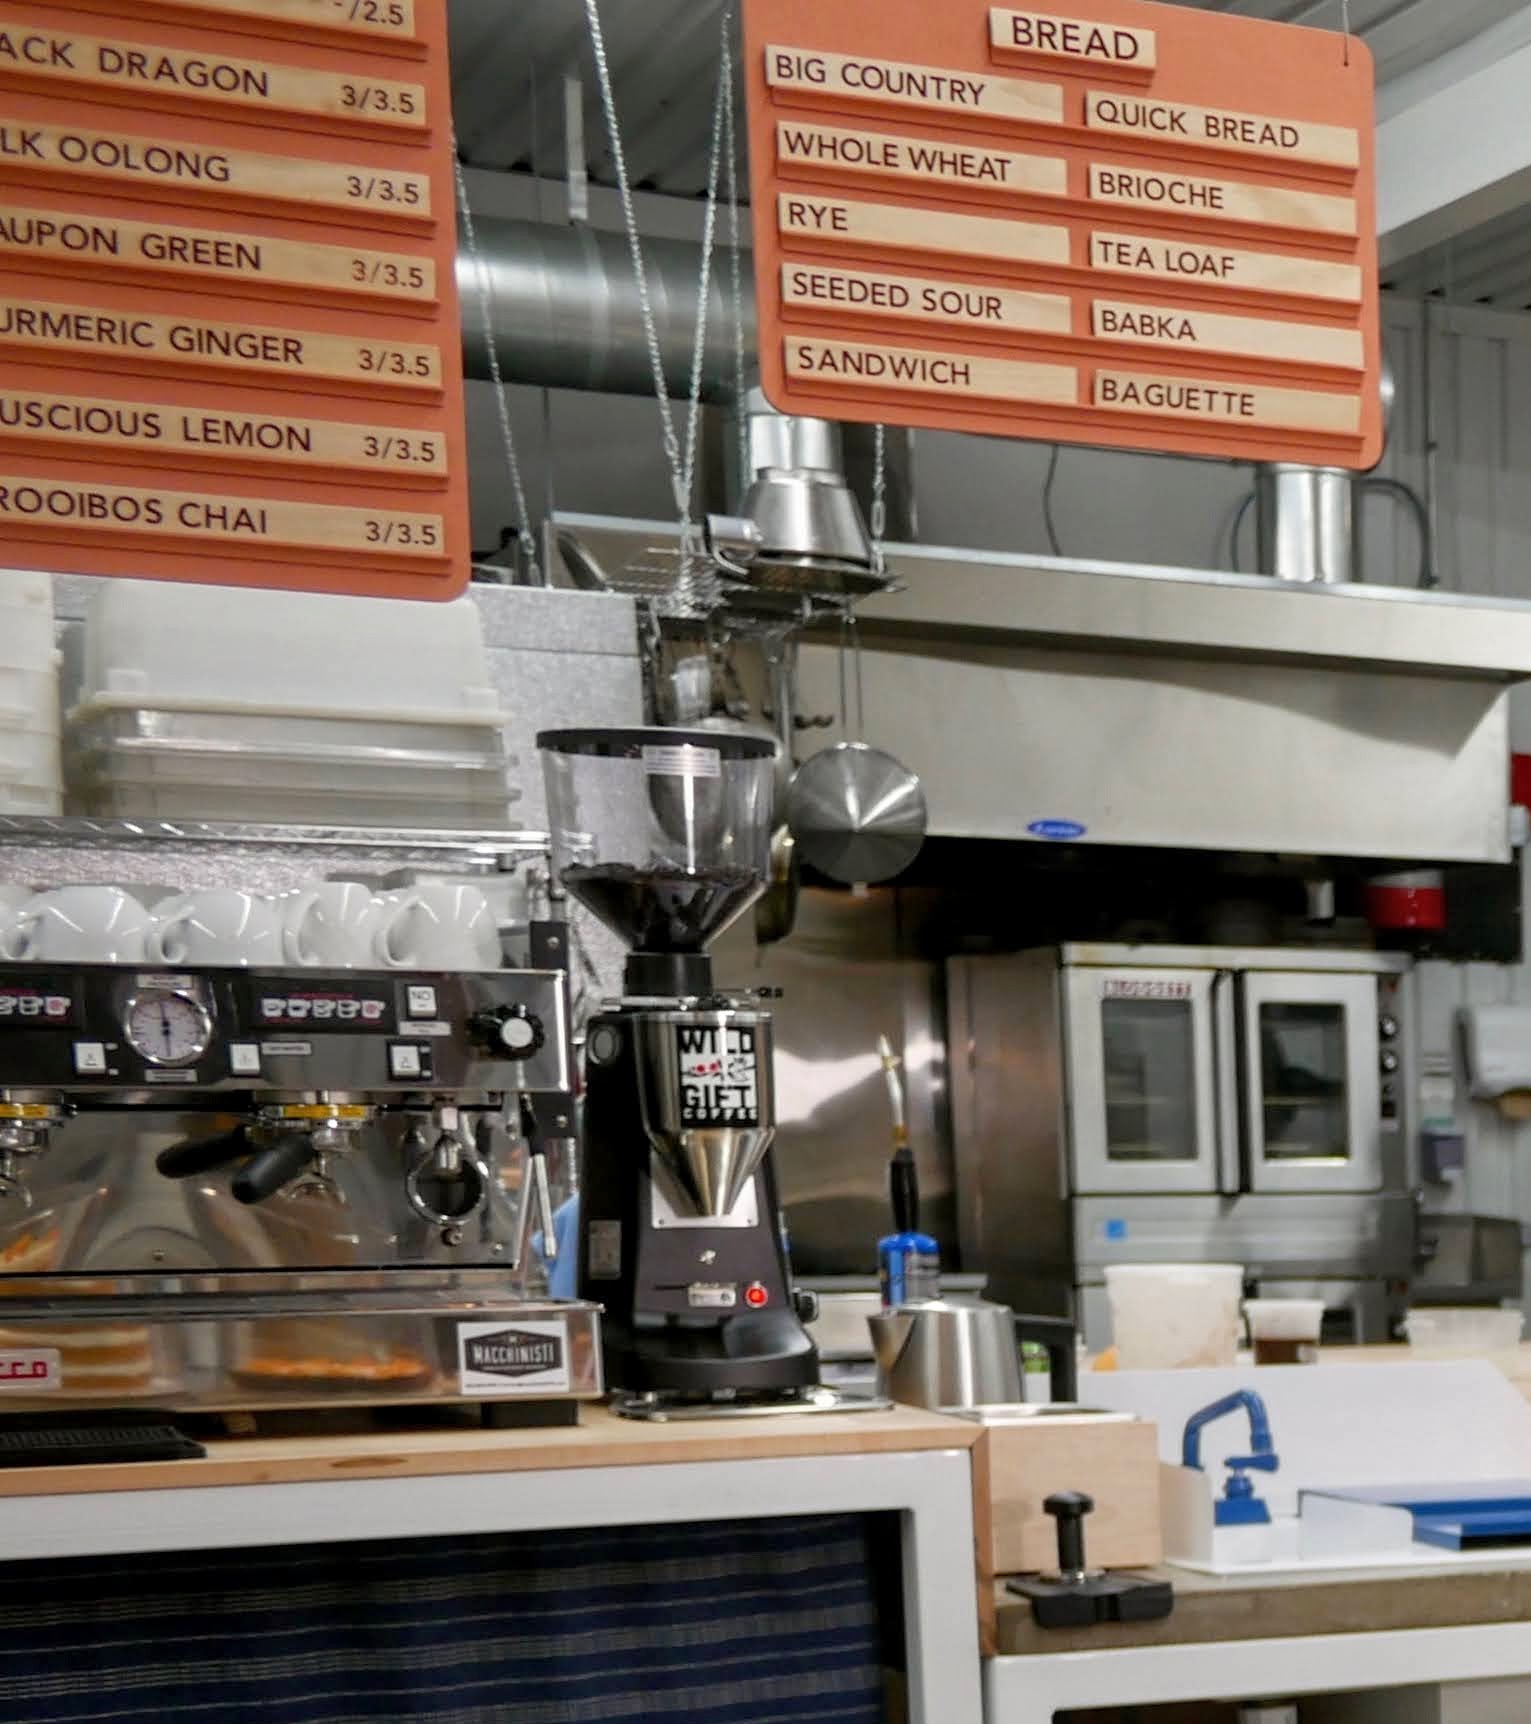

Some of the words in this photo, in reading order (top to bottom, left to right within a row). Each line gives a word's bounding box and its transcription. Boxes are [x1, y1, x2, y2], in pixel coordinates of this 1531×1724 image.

[1012, 16, 1140, 60] BREAD
[99, 48, 270, 98] DRAGON
[340, 84, 415, 115] 3/3.5
[775, 55, 826, 83] BIG
[841, 62, 986, 106] COUNTRY
[1095, 98, 1188, 134] QUICK
[1204, 115, 1299, 149] BREAD
[59, 136, 230, 182] OOLONG
[345, 175, 419, 204] 3/3.5
[783, 131, 900, 168] WHOLE
[907, 147, 1012, 182] WHEAT
[1098, 171, 1225, 210] BRIOCHE
[788, 203, 849, 231] RYE
[140, 234, 262, 271] GREEN
[350, 260, 424, 289] 3/3.5
[1098, 240, 1155, 268] TEA
[1165, 250, 1236, 279] LOAF
[792, 271, 910, 309] SEEDED
[922, 290, 1003, 321] SOUR
[1101, 309, 1197, 342] BABKA
[169, 326, 304, 365] GINGER
[358, 349, 431, 377] 3/3.5
[797, 345, 971, 386] SANDWICH
[1101, 377, 1256, 417] BAGUETTE
[0, 399, 161, 439] USCIOUS
[182, 417, 311, 453] LEMON
[363, 436, 435, 463] 3/3.5
[178, 503, 267, 534] CHAI
[365, 521, 436, 546] 3/3.5
[682, 1084, 751, 1108] GIFT
[682, 1107, 758, 1120] COFFEE
[473, 1343, 555, 1364] MACCHINISTI
